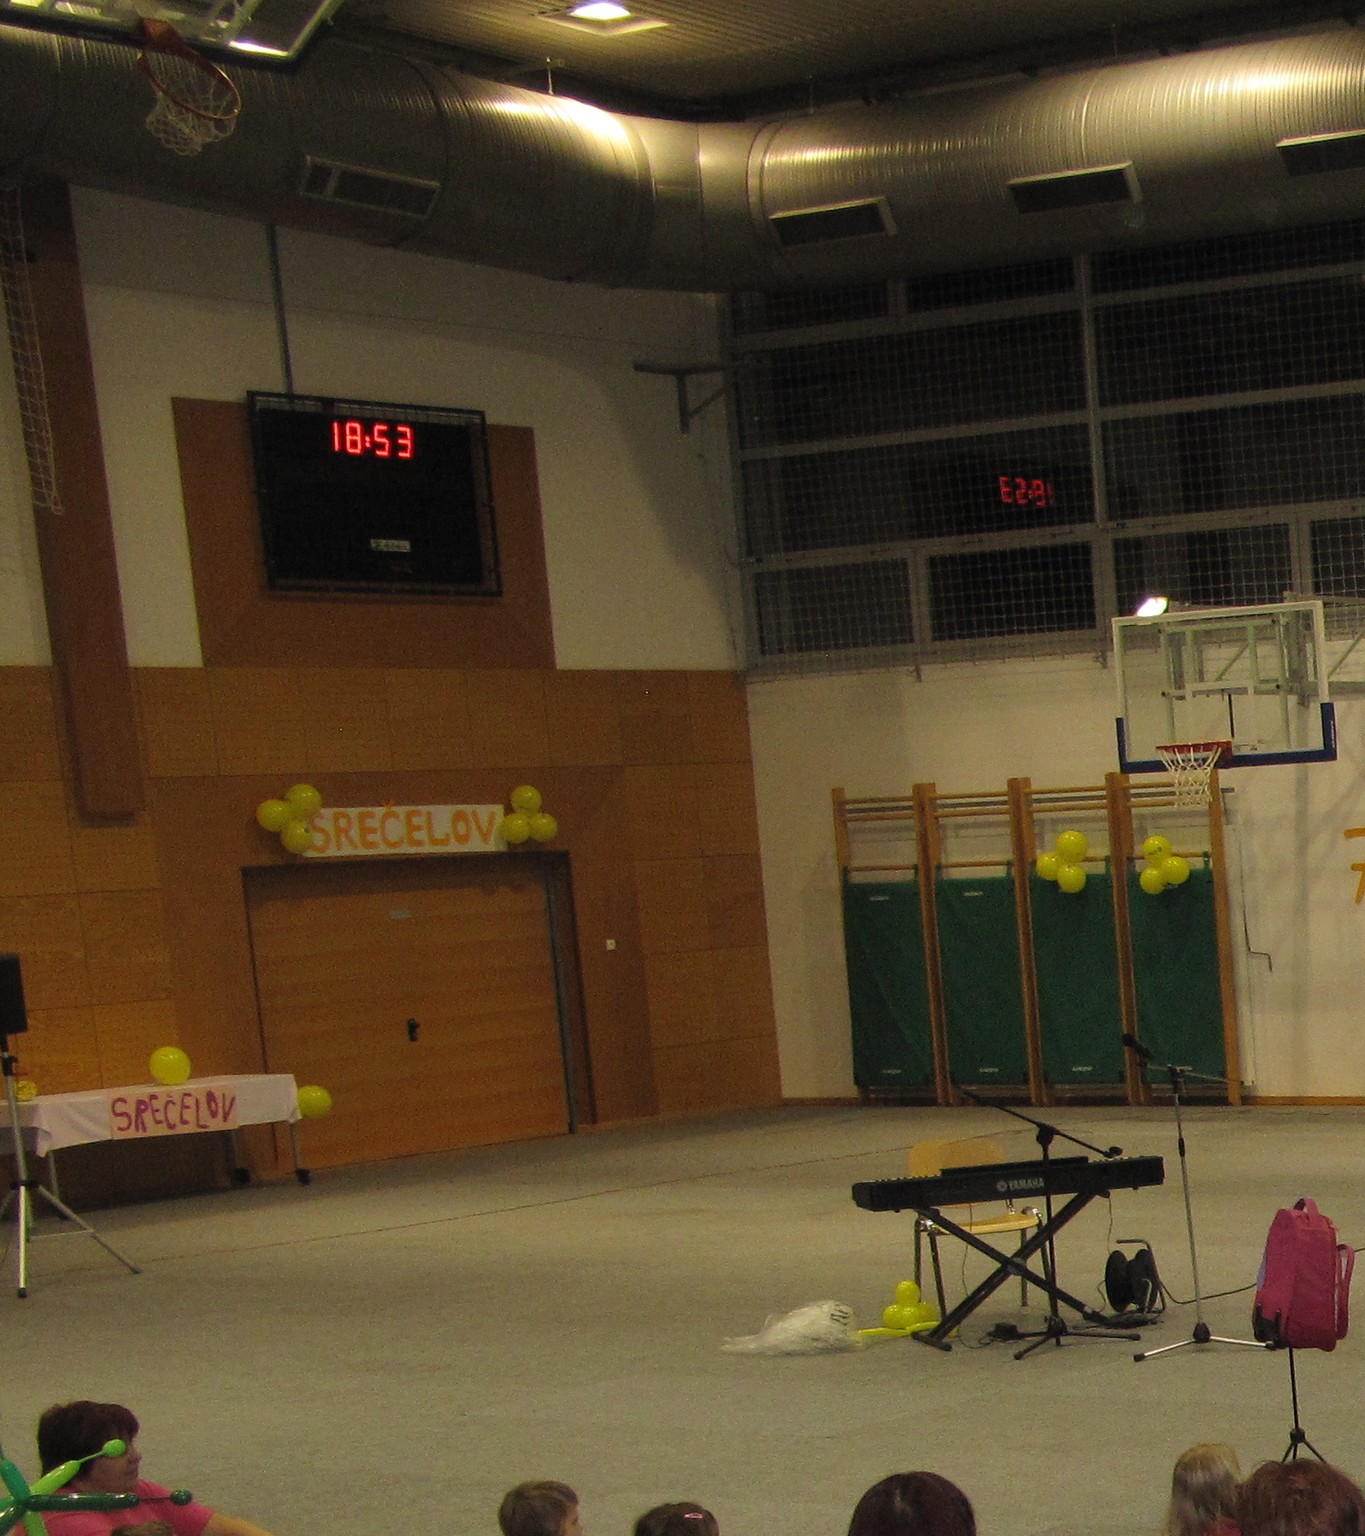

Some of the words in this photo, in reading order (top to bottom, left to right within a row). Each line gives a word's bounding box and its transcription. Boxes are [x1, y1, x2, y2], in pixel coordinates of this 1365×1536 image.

[332, 421, 415, 458] 18:53
[307, 801, 498, 854] SREČELOV
[111, 1090, 237, 1133] SREČELOV
